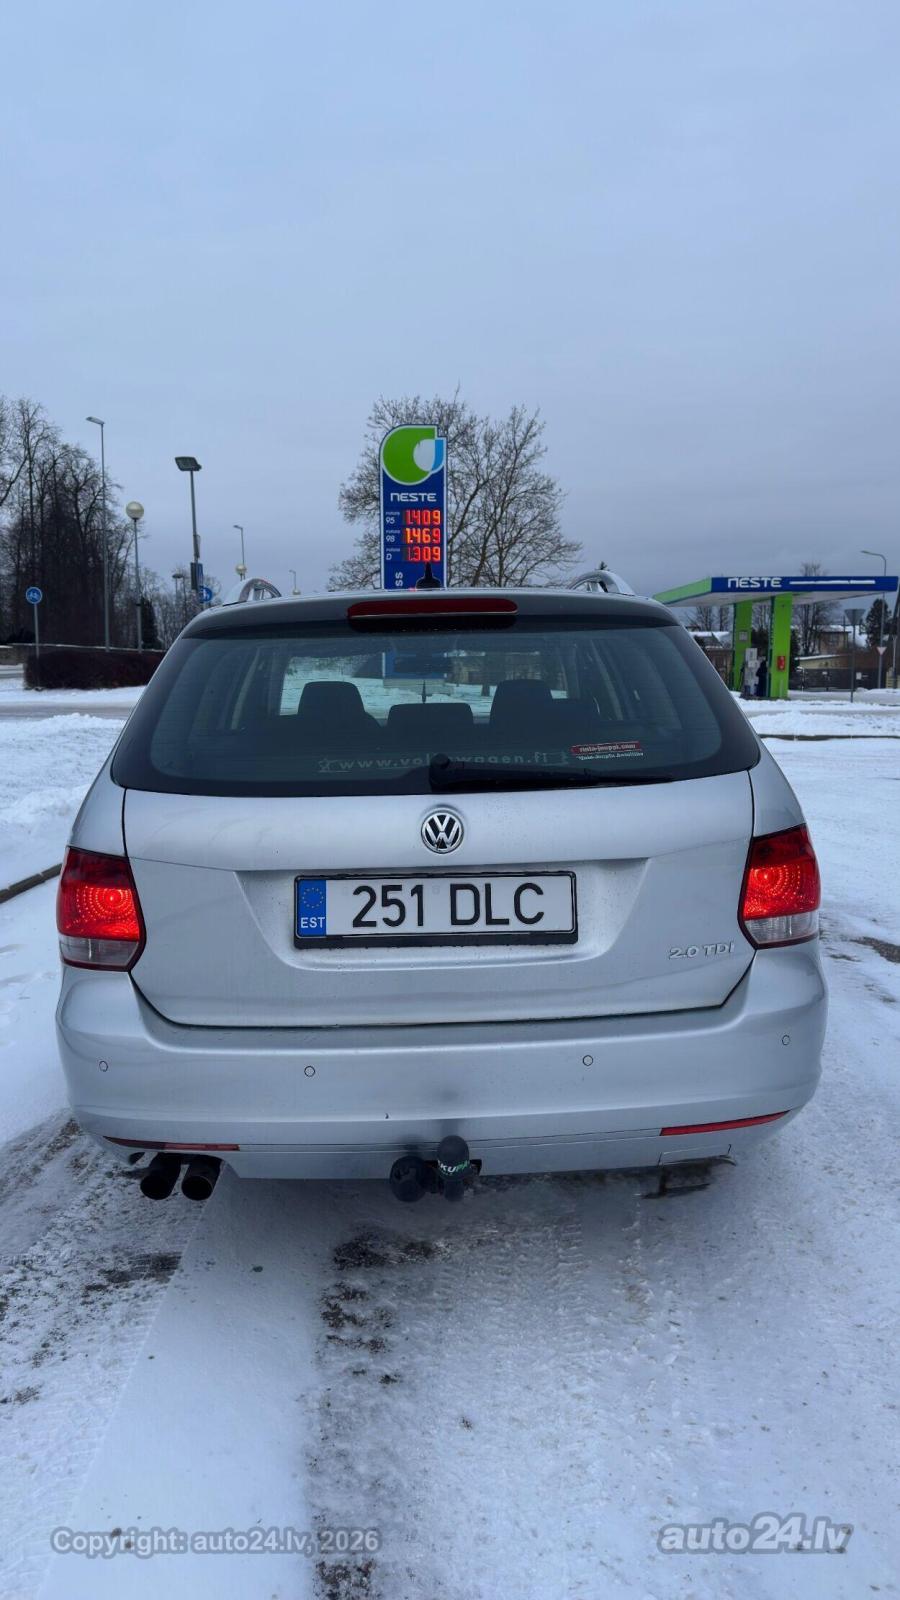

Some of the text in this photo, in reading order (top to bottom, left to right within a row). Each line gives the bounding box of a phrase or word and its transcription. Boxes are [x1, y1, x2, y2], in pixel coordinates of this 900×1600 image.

[390, 492, 437, 502] NESTE
[405, 527, 441, 544] 1.469
[727, 576, 782, 588] NESTE
[339, 752, 548, 769] www.volwagen.fi
[352, 882, 545, 928] 251 DLC
[300, 916, 326, 929] EST
[668, 940, 735, 960] 2.0 TDI
